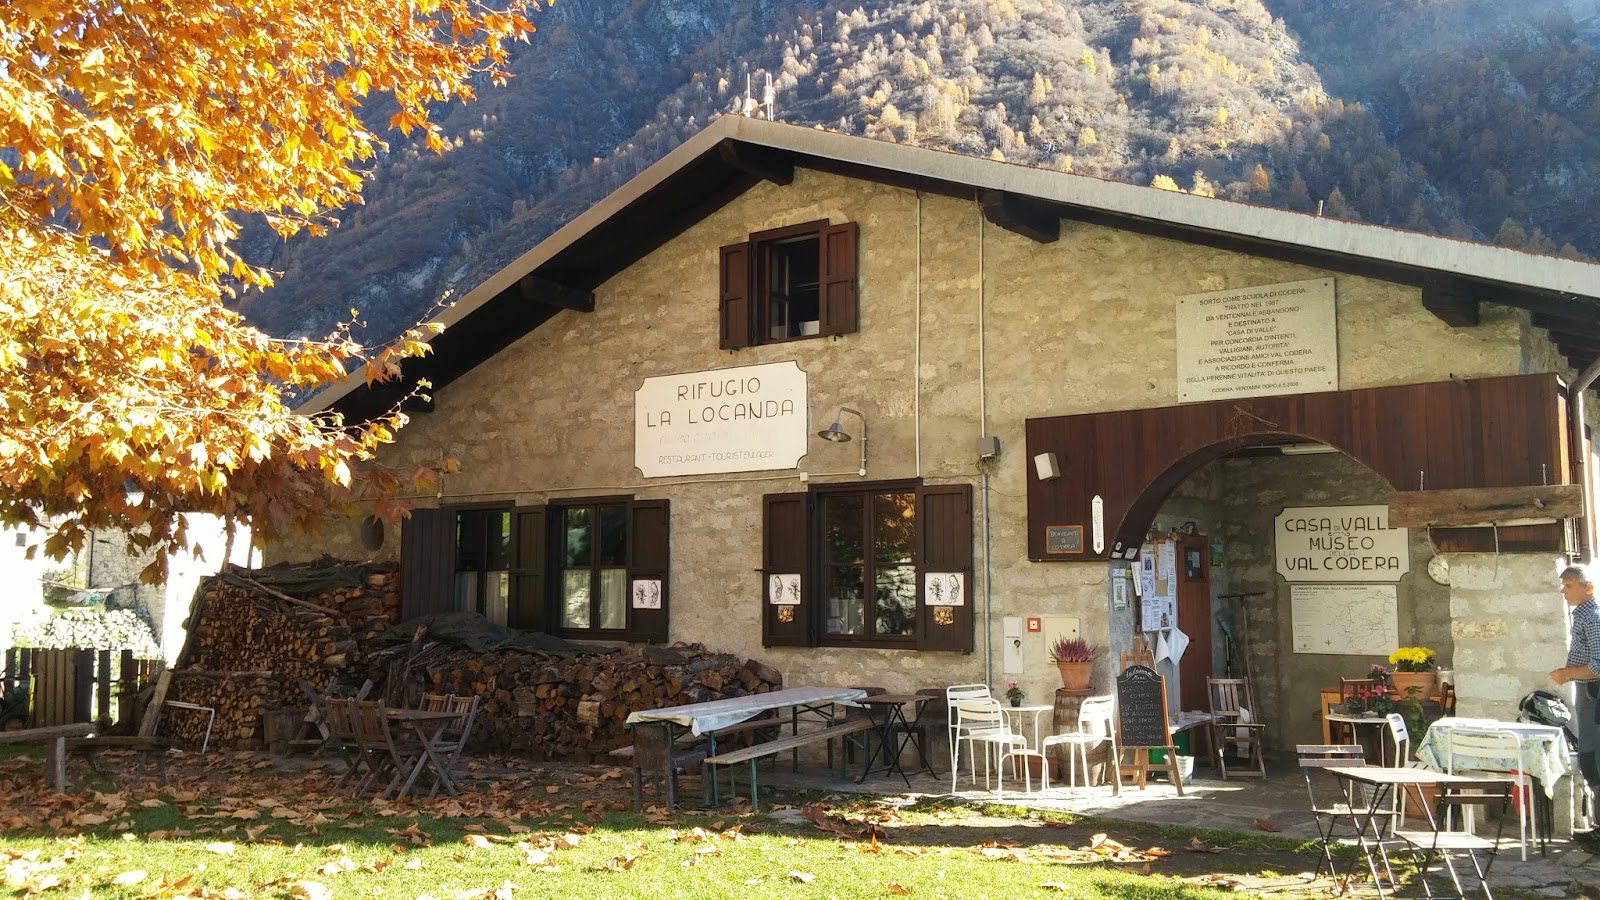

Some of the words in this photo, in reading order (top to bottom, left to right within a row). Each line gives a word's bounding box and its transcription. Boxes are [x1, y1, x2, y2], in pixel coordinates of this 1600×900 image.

[1215, 310, 1257, 320] VENTENNALE
[1258, 306, 1300, 315] ABBANDONO
[1224, 303, 1250, 311] TRATTO
[1234, 318, 1270, 327] DESTINATO
[1225, 336, 1263, 345] CONCORDIA
[1204, 354, 1250, 364] ASSOCIAZIONE
[1220, 363, 1251, 371] RICORDO
[1257, 359, 1295, 368] CONFERMA
[1206, 373, 1236, 381] PERENNE
[1275, 368, 1303, 376] QUESTO
[677, 377, 761, 401] RIFUGIO
[647, 411, 671, 428] LA
[688, 399, 794, 425] LOCANDA
[1284, 517, 1331, 532] CASA
[1309, 536, 1375, 551] MUSEO
[1285, 557, 1319, 571] VAL
[1323, 556, 1399, 571] CODERA
